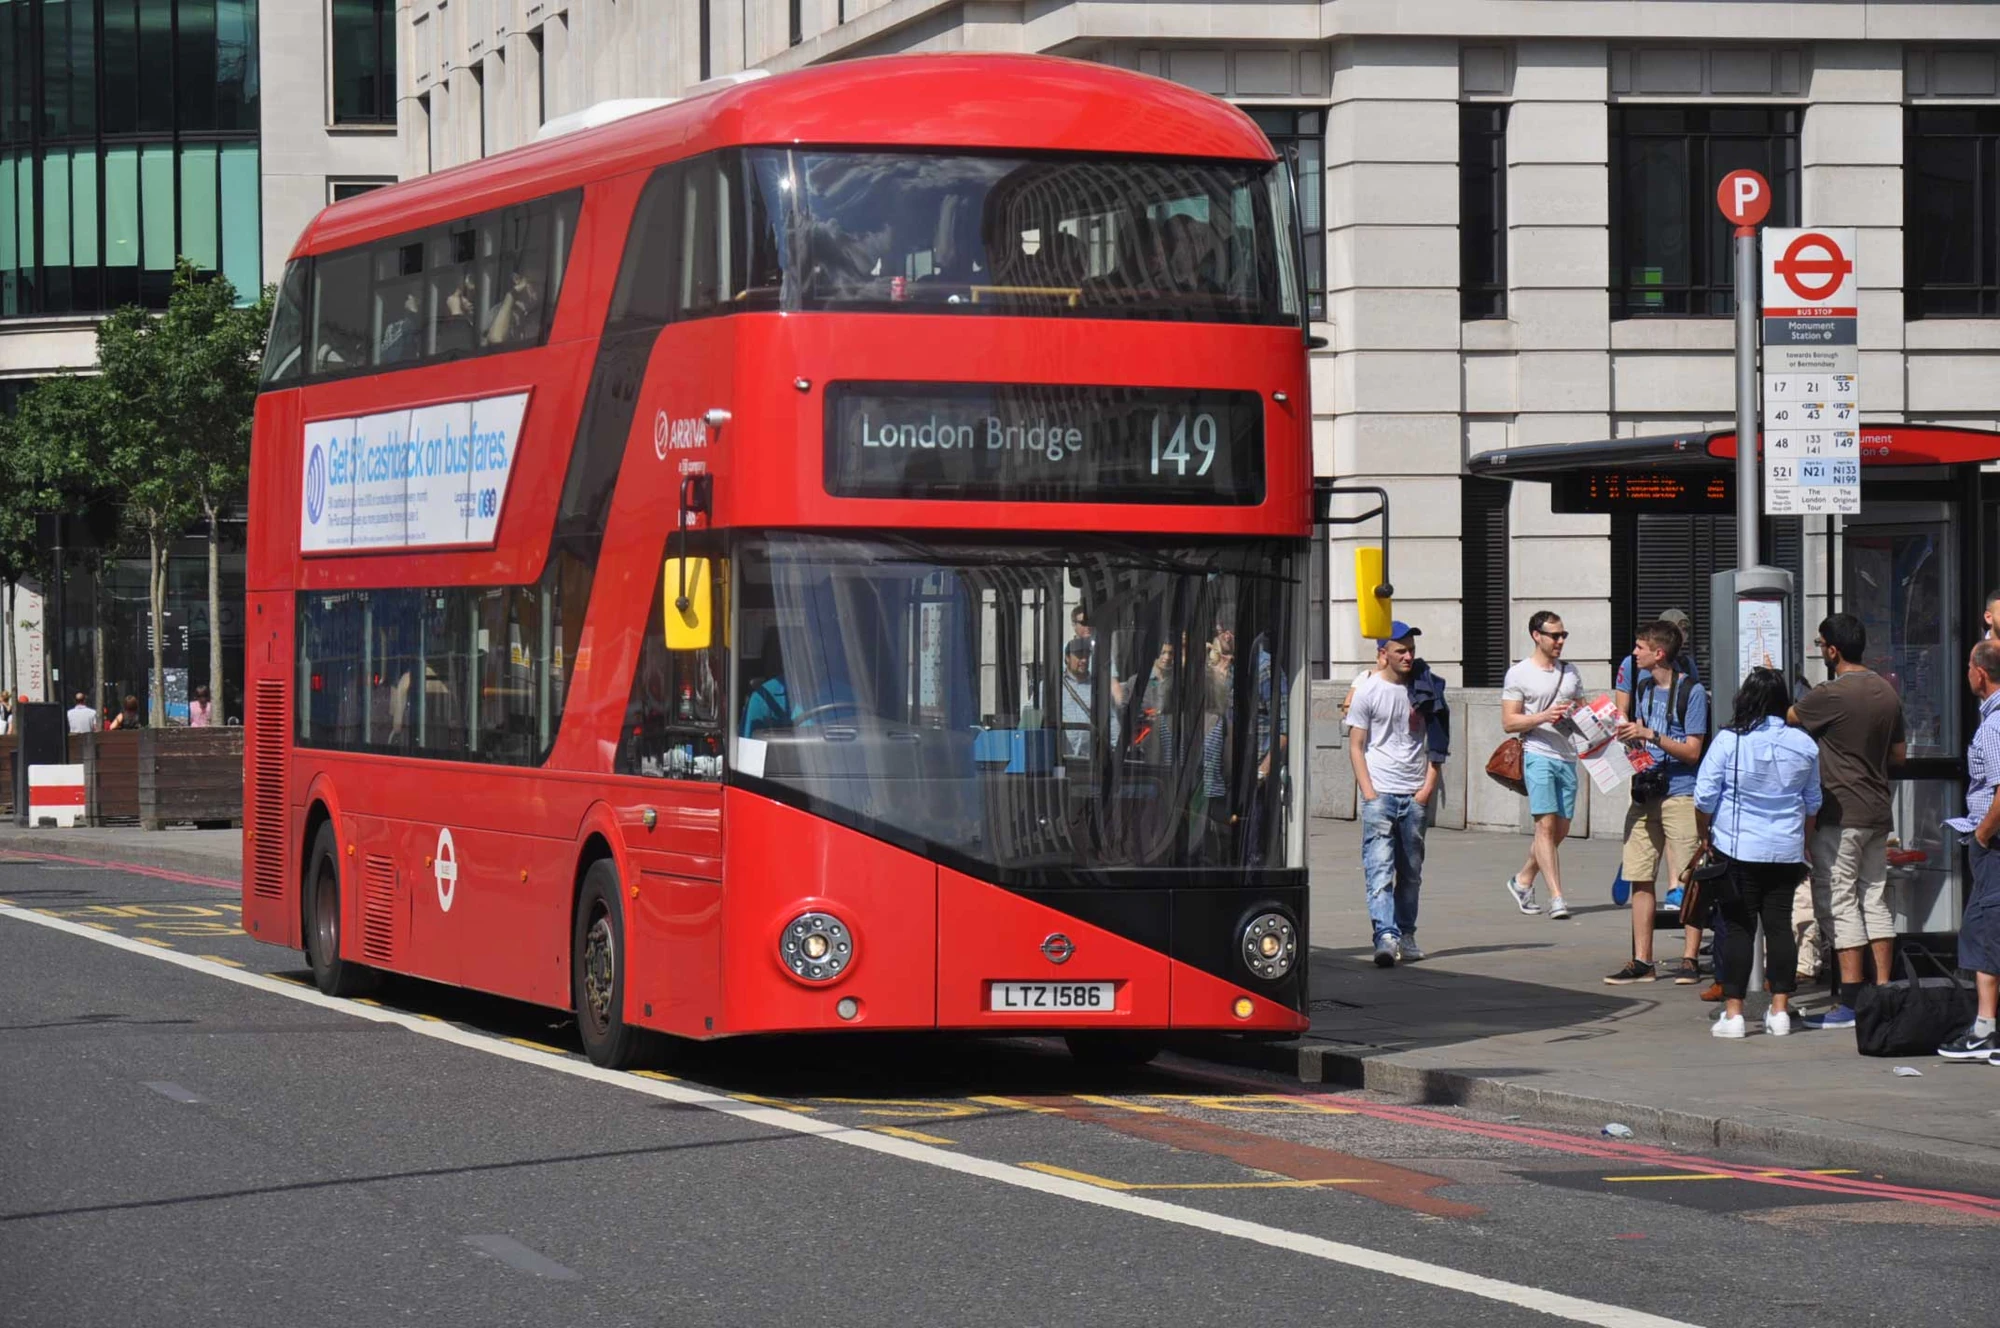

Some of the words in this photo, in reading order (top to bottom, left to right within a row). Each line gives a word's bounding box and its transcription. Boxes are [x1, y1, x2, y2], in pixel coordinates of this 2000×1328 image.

[1735, 177, 1760, 217] P
[1788, 322, 1835, 330] Monument
[1791, 331, 1821, 340] Station
[1813, 352, 1839, 360] Borough
[1797, 361, 1836, 369] Bermondsey
[1774, 382, 1787, 393] 17
[1807, 382, 1819, 393] 21
[1837, 382, 1850, 392] 35
[1775, 410, 1789, 421] 40
[1807, 410, 1820, 420] 43
[1838, 410, 1850, 420] 47
[668, 417, 708, 450] ARRIVA
[862, 413, 974, 448] London
[985, 416, 1084, 461] Bridge
[1775, 438, 1789, 448] 48
[1806, 435, 1821, 444] 133
[1835, 438, 1853, 448] 149
[1859, 434, 1893, 444] ument
[1149, 413, 1218, 476] 149
[329, 437, 349, 486] Get
[367, 427, 425, 482] cashback
[427, 438, 442, 478] on
[445, 422, 468, 475] bus
[1806, 446, 1821, 454] 141
[1773, 466, 1792, 477] 521
[1804, 466, 1825, 477] N21
[1833, 466, 1857, 474] N133
[1833, 475, 1857, 484] N199
[1833, 497, 1858, 505] Original
[1005, 986, 1047, 1007] LTZ
[1053, 986, 1101, 1007] 1586
